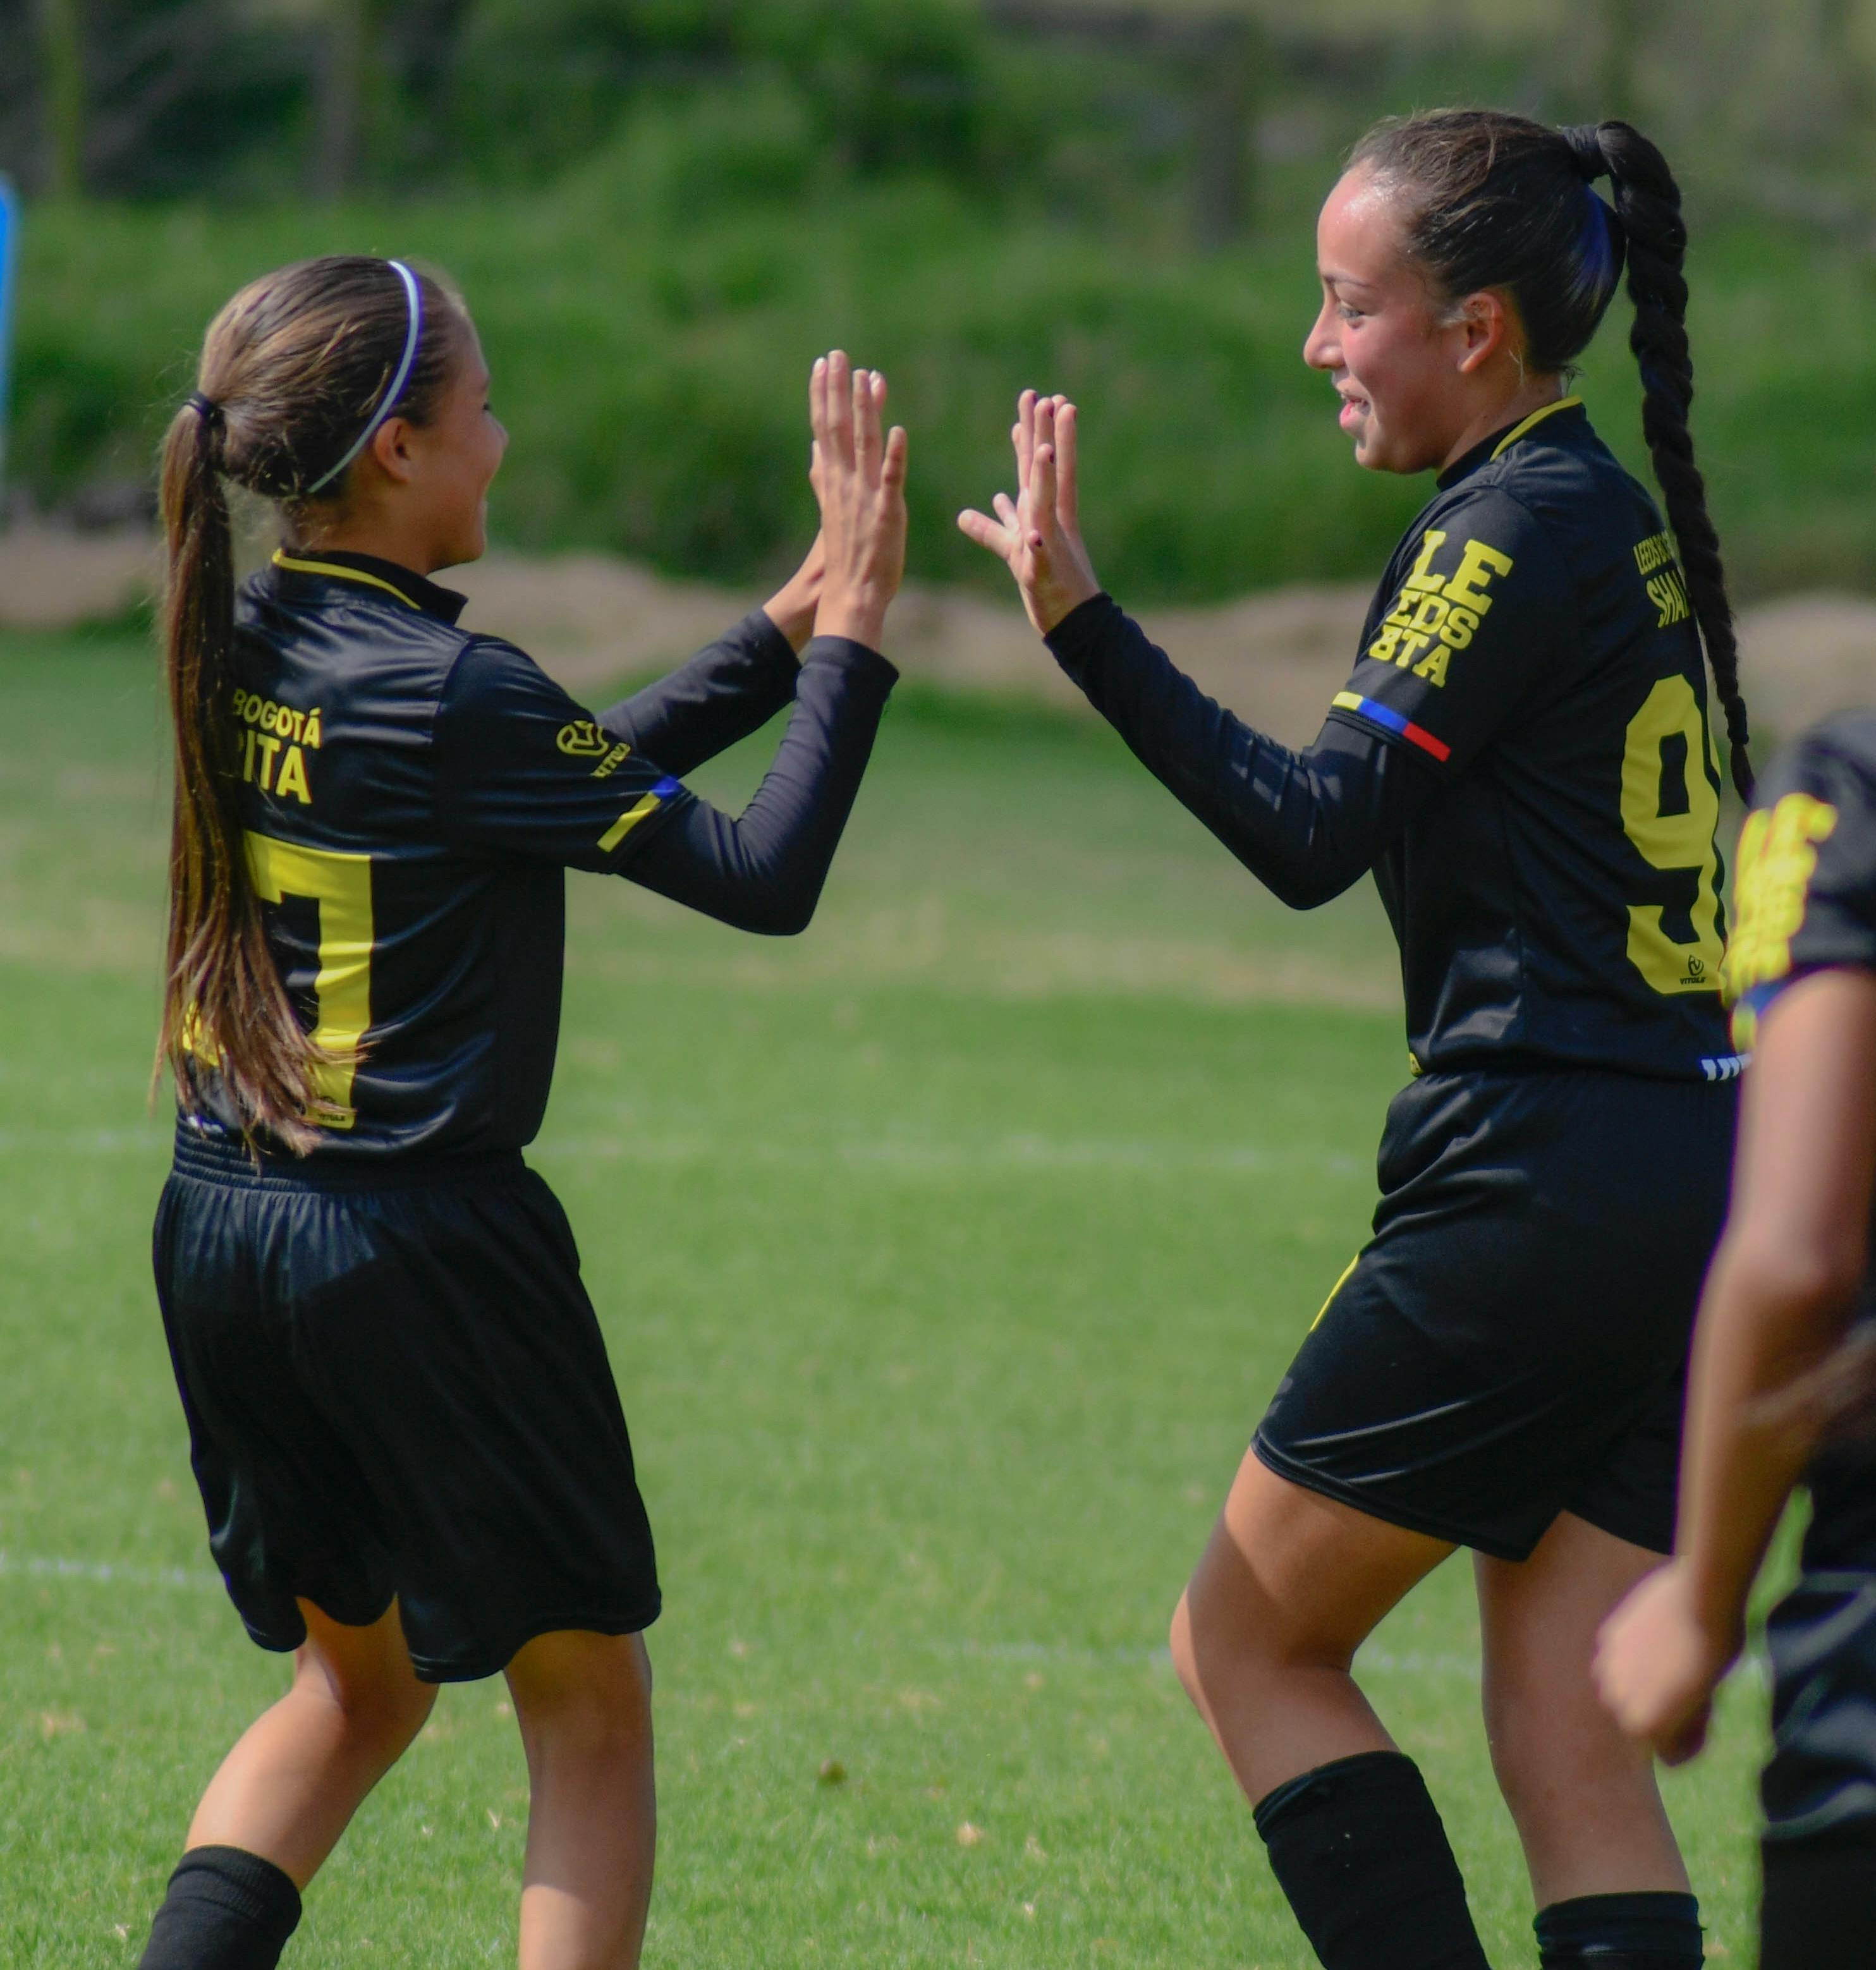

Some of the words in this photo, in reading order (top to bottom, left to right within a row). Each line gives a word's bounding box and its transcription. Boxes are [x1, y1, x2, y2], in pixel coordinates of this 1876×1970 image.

[1405, 530, 1514, 616] LE
[1385, 588, 1480, 650] EDS
[232, 688, 322, 750] BOGOTÁ
[238, 729, 314, 805] ITA
